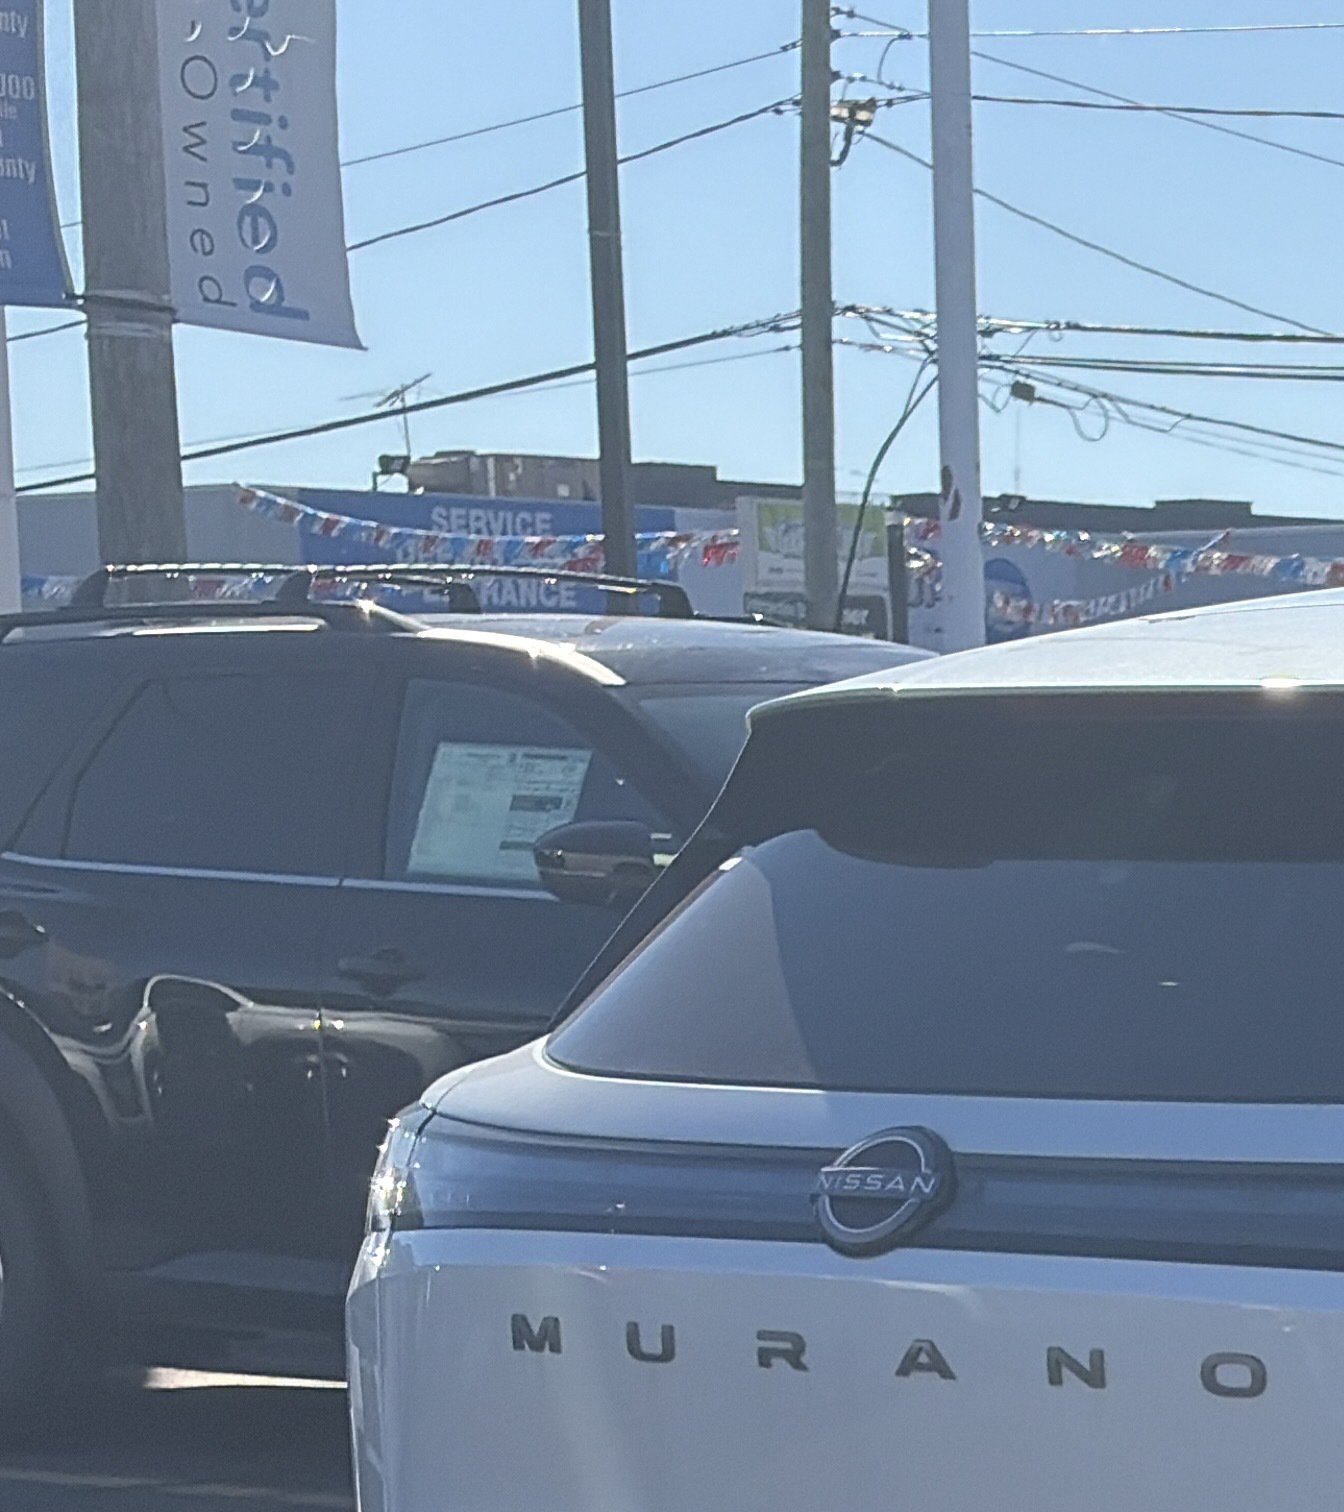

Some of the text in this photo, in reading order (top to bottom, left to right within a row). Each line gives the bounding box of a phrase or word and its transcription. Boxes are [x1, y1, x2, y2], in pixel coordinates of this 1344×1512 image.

[430, 505, 553, 535] SERVICE
[816, 1173, 936, 1194] NISSAN
[509, 1312, 1268, 1400] MURANO
